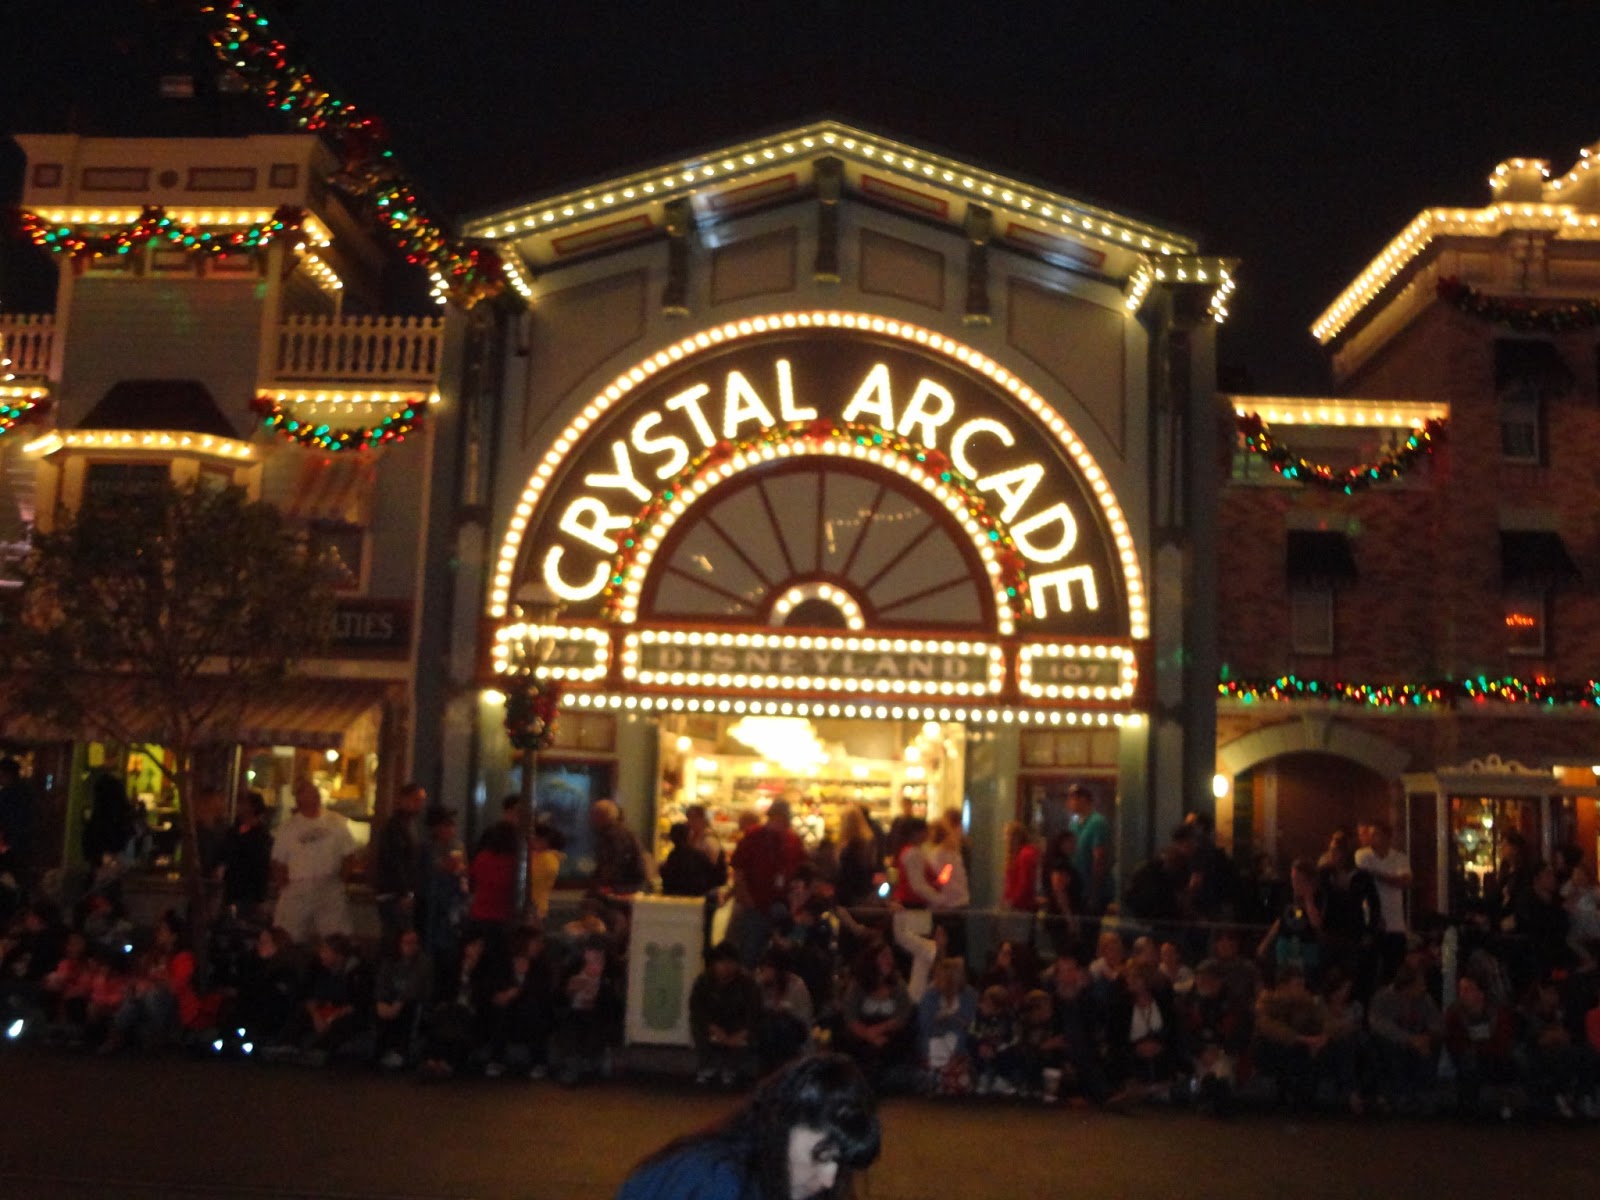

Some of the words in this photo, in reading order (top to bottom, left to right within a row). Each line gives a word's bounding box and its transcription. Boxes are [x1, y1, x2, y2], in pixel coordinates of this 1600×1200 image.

[543, 359, 818, 603] CRYSTAL
[843, 363, 1099, 620] ARCADE
[657, 647, 970, 680] DISNEYLAND
[1049, 663, 1101, 680] 107
